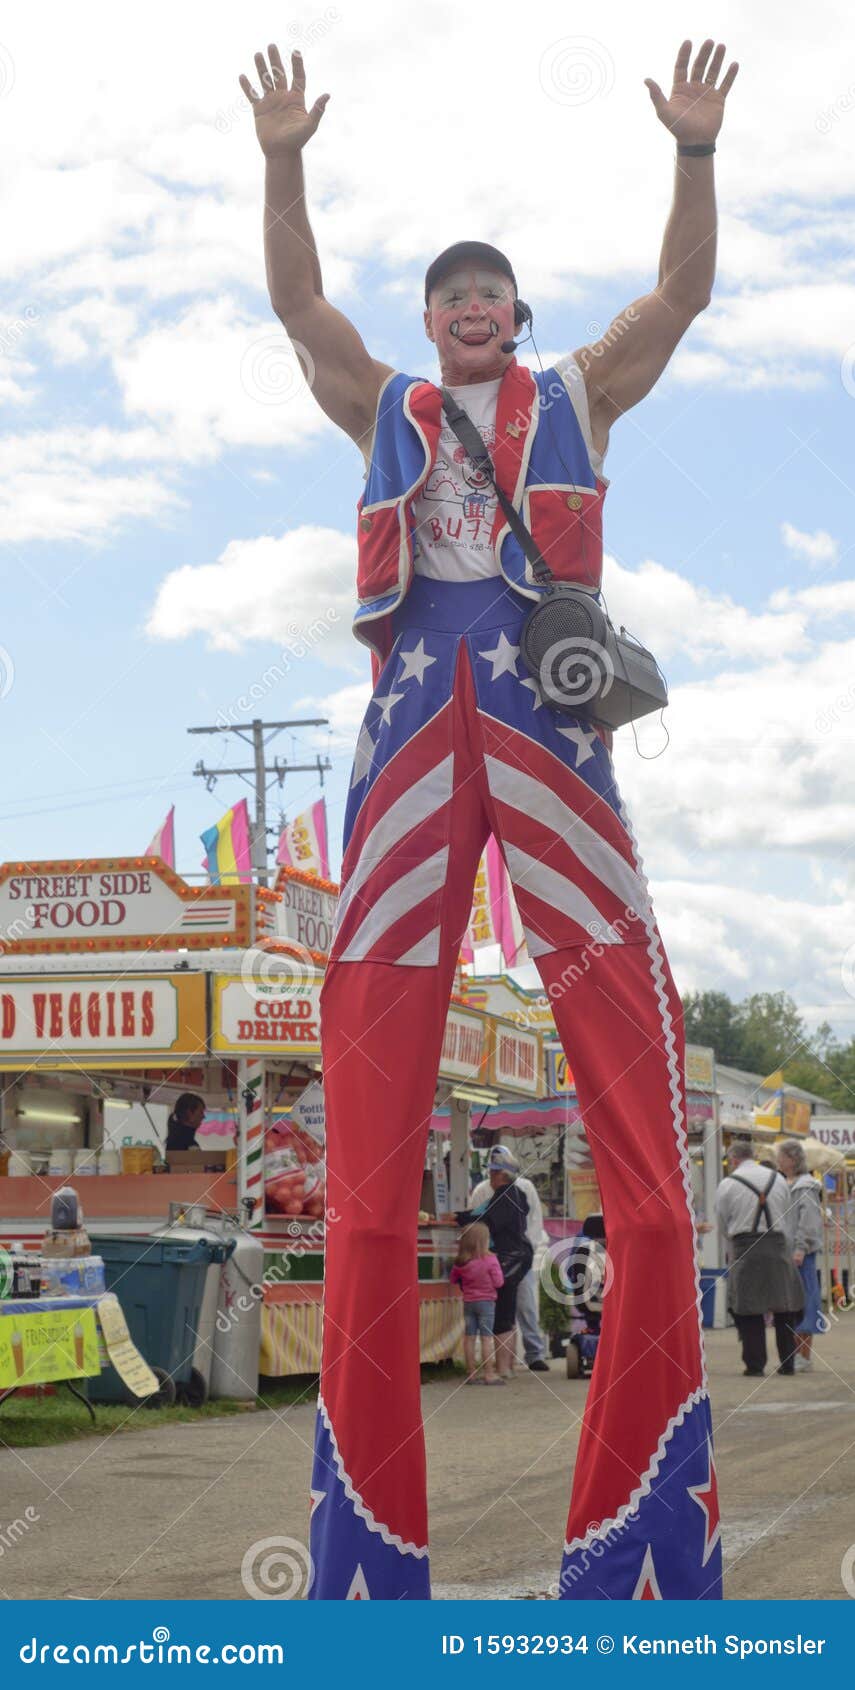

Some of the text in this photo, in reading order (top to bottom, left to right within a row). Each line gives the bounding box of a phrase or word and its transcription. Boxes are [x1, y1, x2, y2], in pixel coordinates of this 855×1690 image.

[9, 872, 152, 900] STREET SIDE
[284, 883, 325, 918] STREET
[31, 900, 126, 929] FOOD
[32, 991, 154, 1038] VEGGIES
[255, 999, 312, 1019] COLD
